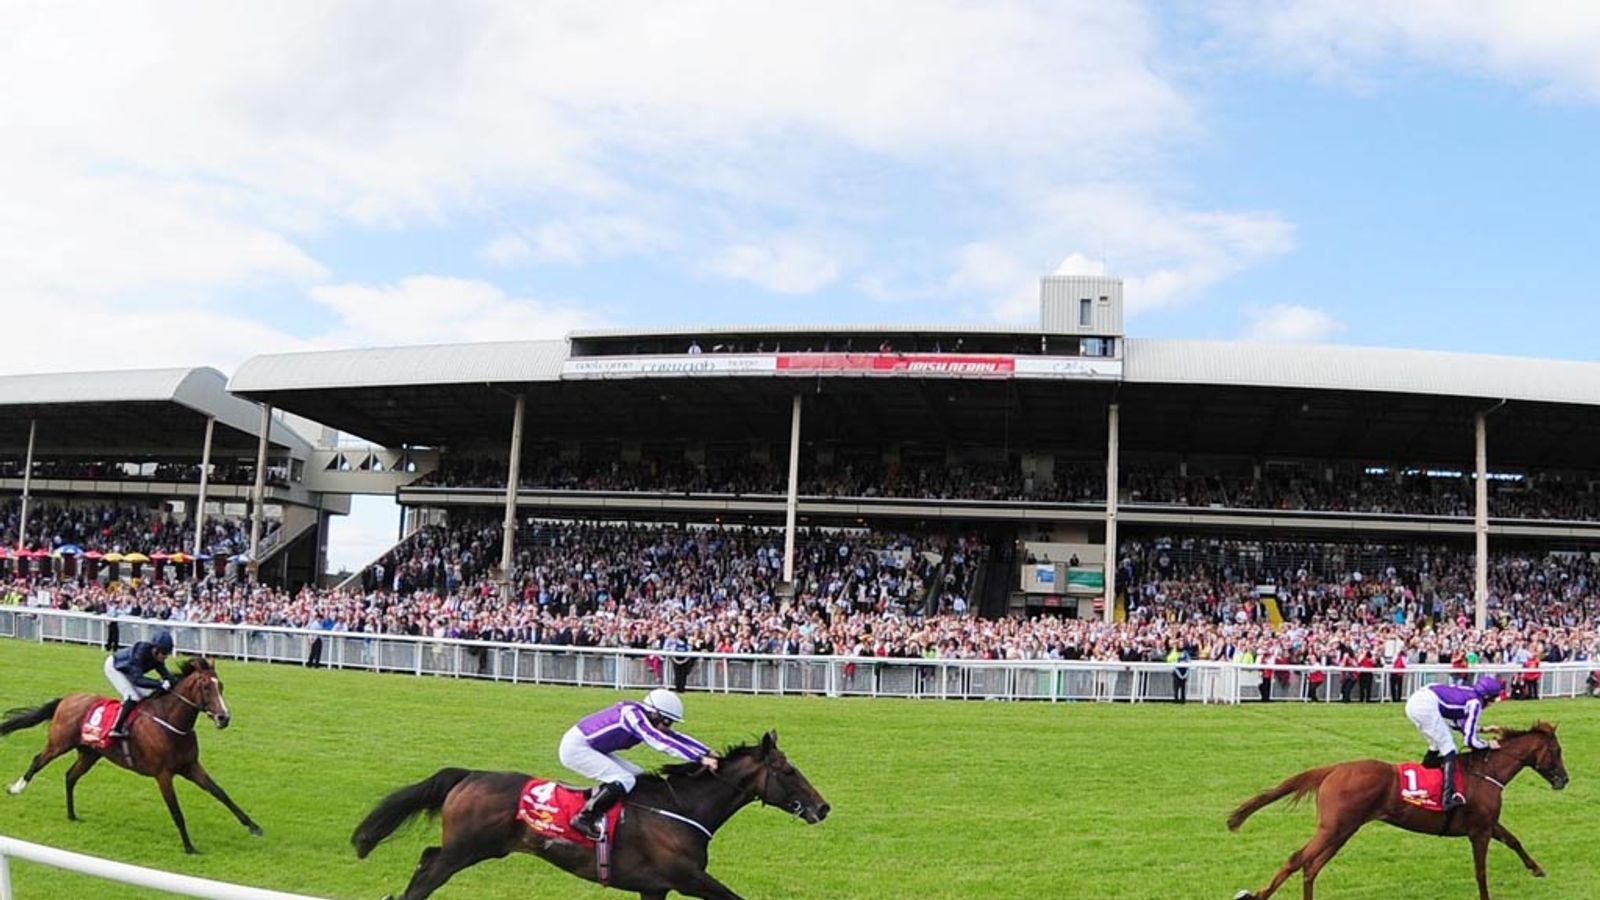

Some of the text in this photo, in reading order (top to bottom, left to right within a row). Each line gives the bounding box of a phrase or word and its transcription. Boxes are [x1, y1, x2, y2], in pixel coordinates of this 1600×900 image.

[908, 361, 997, 373] IRISH DERBY
[90, 705, 105, 727] 6
[1403, 769, 1417, 791] 1
[530, 781, 556, 805] 4
